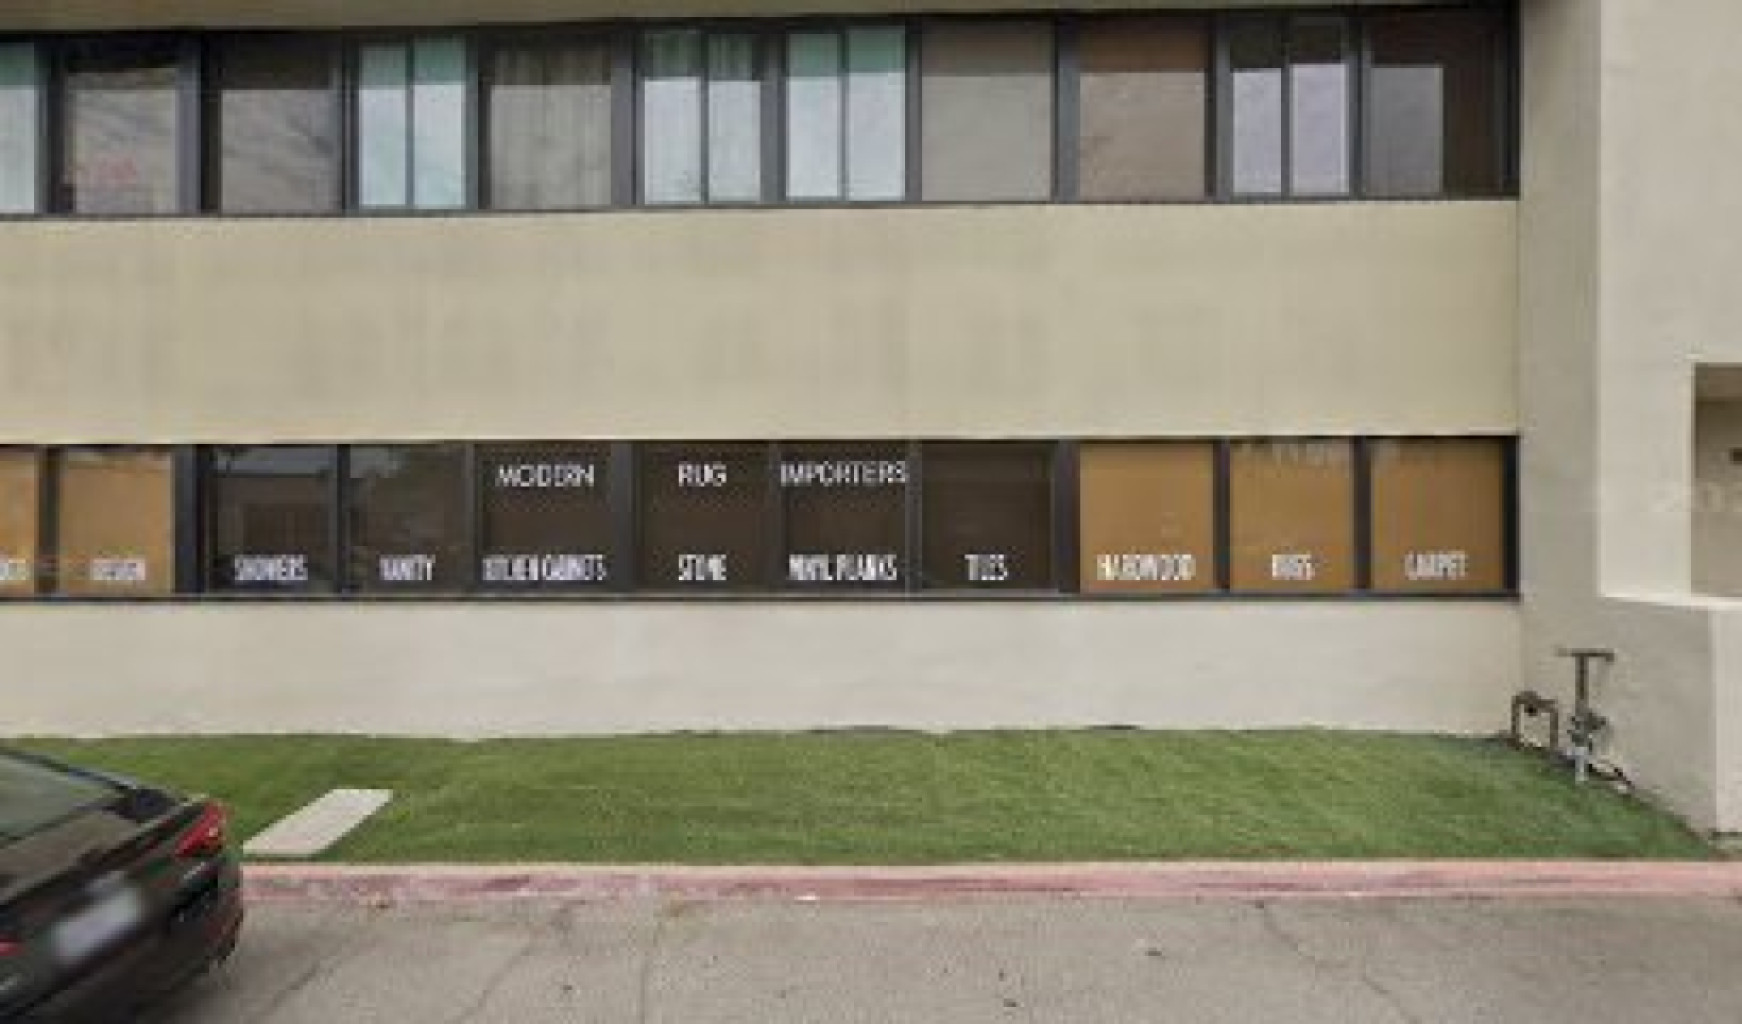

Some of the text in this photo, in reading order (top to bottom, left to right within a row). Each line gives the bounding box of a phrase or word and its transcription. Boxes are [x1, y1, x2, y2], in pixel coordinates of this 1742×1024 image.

[678, 462, 727, 487] RUG
[780, 460, 908, 487] IMPORTERS
[1097, 554, 1196, 581] HARDWOOD
